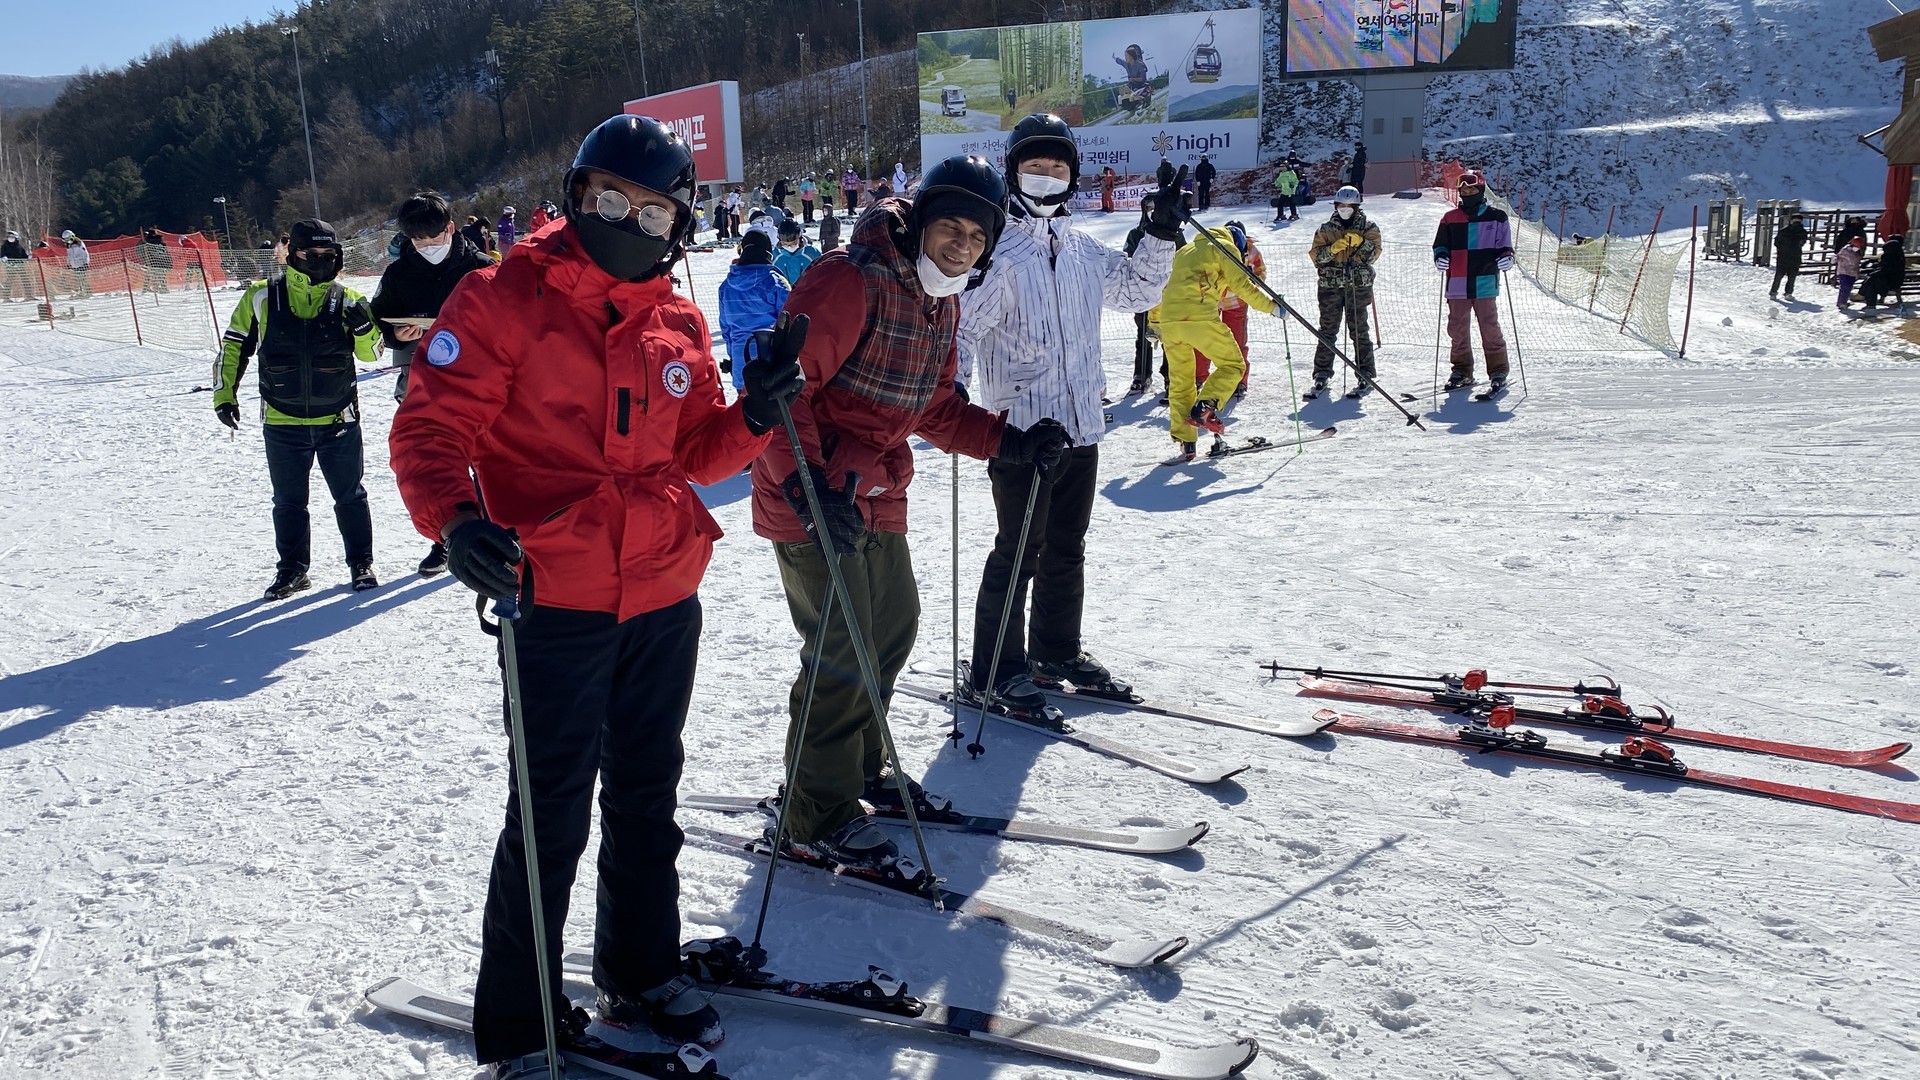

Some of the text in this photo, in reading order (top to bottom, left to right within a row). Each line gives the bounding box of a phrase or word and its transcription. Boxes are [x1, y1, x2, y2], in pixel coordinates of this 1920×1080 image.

[667, 114, 707, 153] 메프
[1176, 132, 1230, 153] high1
[1086, 150, 1130, 165] 국민쉼터
[1187, 153, 1218, 161] RESRT
